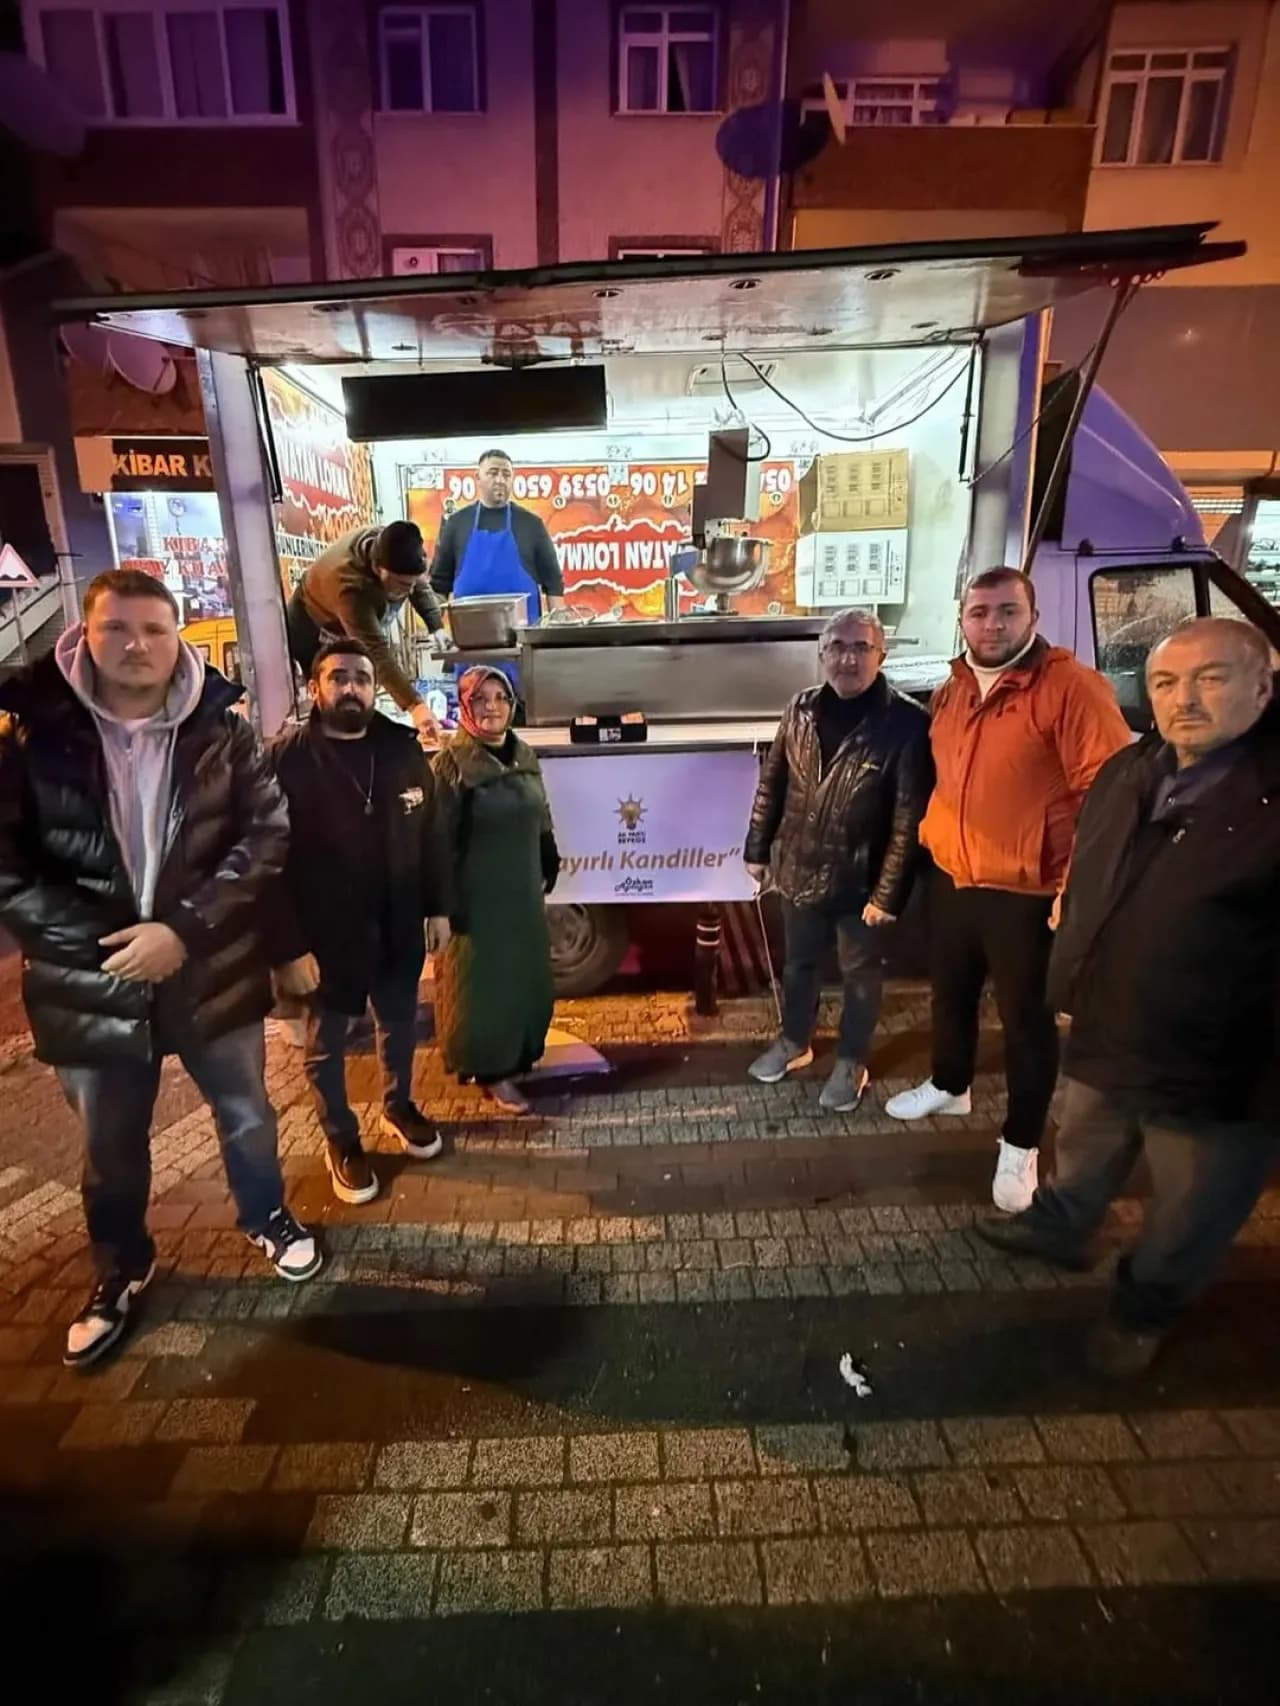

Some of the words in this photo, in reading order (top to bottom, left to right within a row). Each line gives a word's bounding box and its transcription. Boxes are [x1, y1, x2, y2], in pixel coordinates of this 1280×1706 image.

[113, 449, 188, 477] KİBAR
[448, 475, 476, 499] 06
[512, 475, 553, 499] 650
[558, 473, 610, 497] 0539
[631, 471, 656, 495] 06
[661, 471, 687, 495] 14
[554, 542, 620, 571] LOKMA
[626, 541, 681, 570] ATAN
[559, 851, 613, 877] ayırlı
